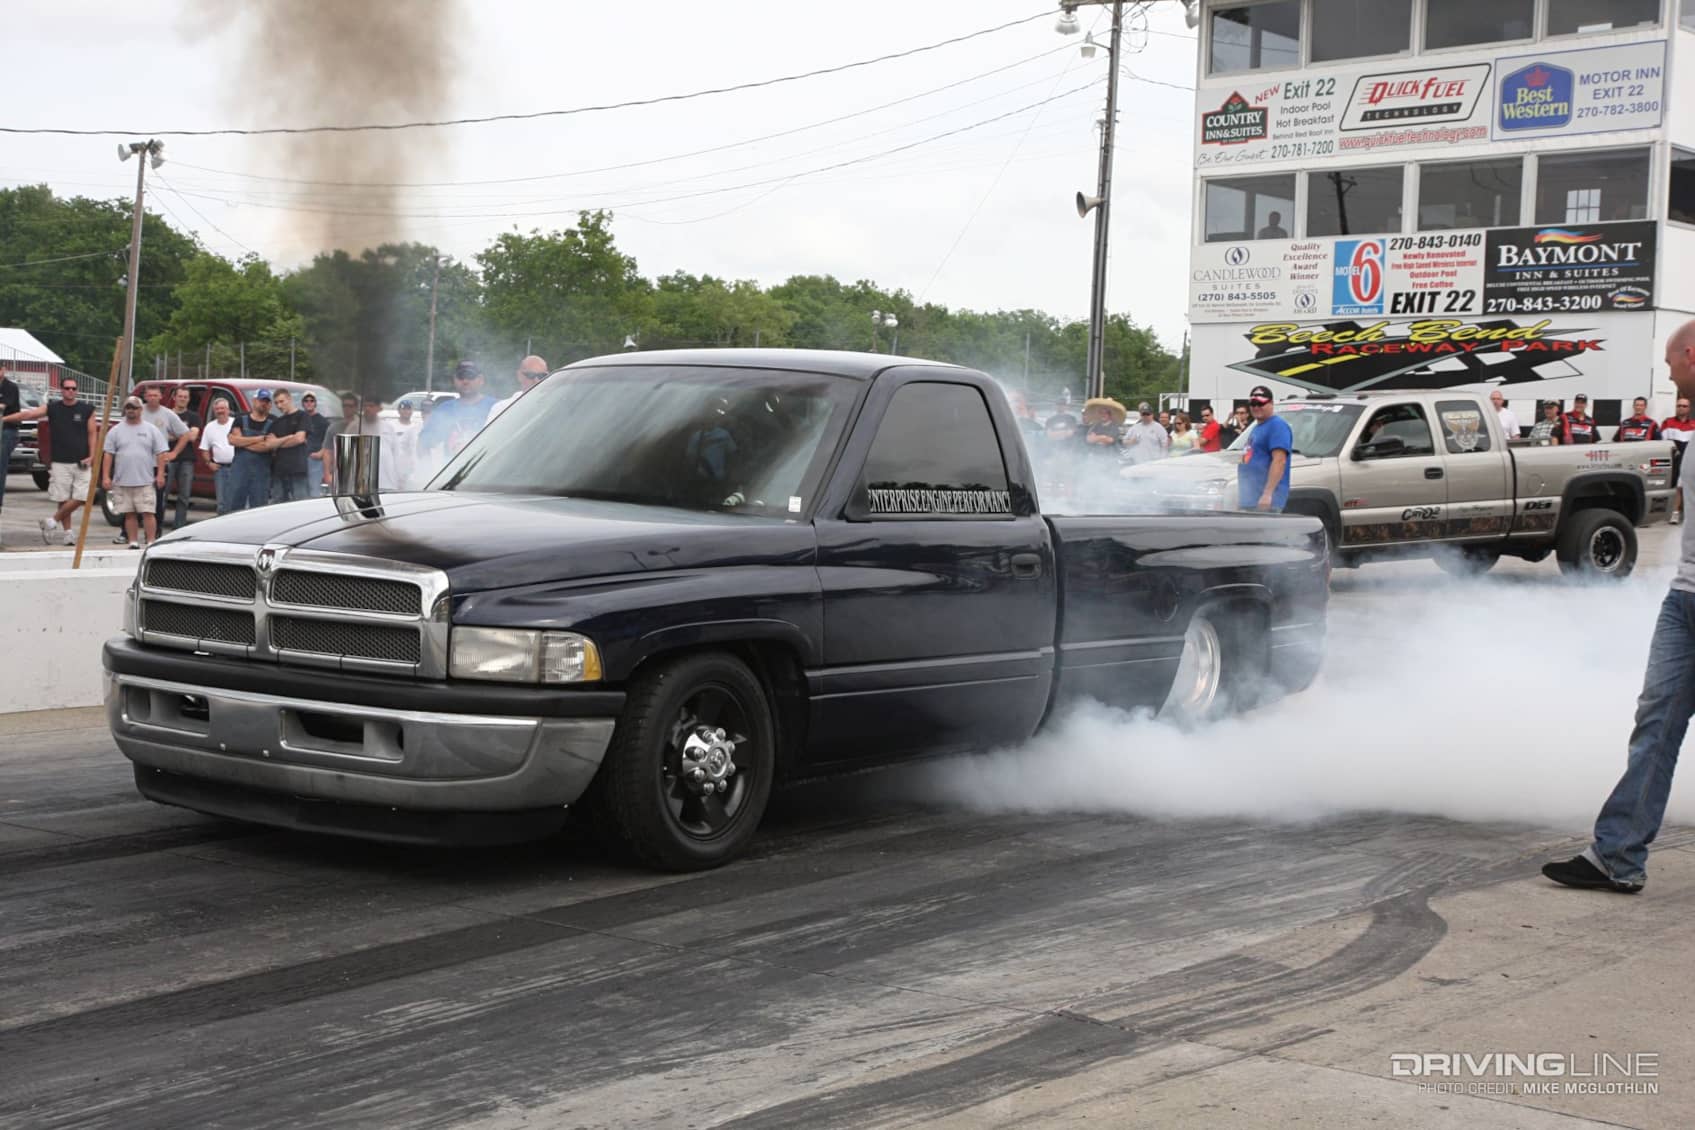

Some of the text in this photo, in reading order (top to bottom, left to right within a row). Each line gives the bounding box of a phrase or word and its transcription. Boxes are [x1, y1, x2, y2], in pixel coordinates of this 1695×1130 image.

[1580, 67, 1660, 85] MOTOR INN
[1255, 84, 1280, 104] NEW
[1284, 78, 1336, 100] Exit 22
[1516, 86, 1552, 104] Best
[1593, 84, 1644, 100] EXIT 22
[1280, 102, 1331, 114] Indoor Pool
[1366, 105, 1458, 119] TECHNOLOGY
[1503, 101, 1568, 120] Western
[1576, 101, 1659, 118] 270-782-3800
[1206, 111, 1262, 127] COUNTRY
[1276, 115, 1334, 128] Hot Breakfast
[1272, 140, 1334, 158] 270-781-7200
[1291, 243, 1321, 252] Quality
[1390, 234, 1481, 250] 270-843-0140
[1283, 252, 1328, 261] Excellence
[1403, 250, 1466, 260] Newly Renovated
[1497, 242, 1642, 267] BAYMONT
[1194, 267, 1281, 281] CANDLEWOOD
[1336, 266, 1360, 276] MOTEL
[1350, 241, 1382, 303] 6
[1515, 272, 1543, 280] INN
[1565, 268, 1619, 278] SUITES
[1212, 283, 1260, 291] SUITES
[1198, 292, 1276, 302] (270) 843-5505
[1390, 290, 1476, 314] EXIT 22
[1487, 295, 1602, 312] 270-843-3200
[1250, 319, 1552, 344] Beech Bend
[1311, 340, 1603, 354] RACEWAY PARK
